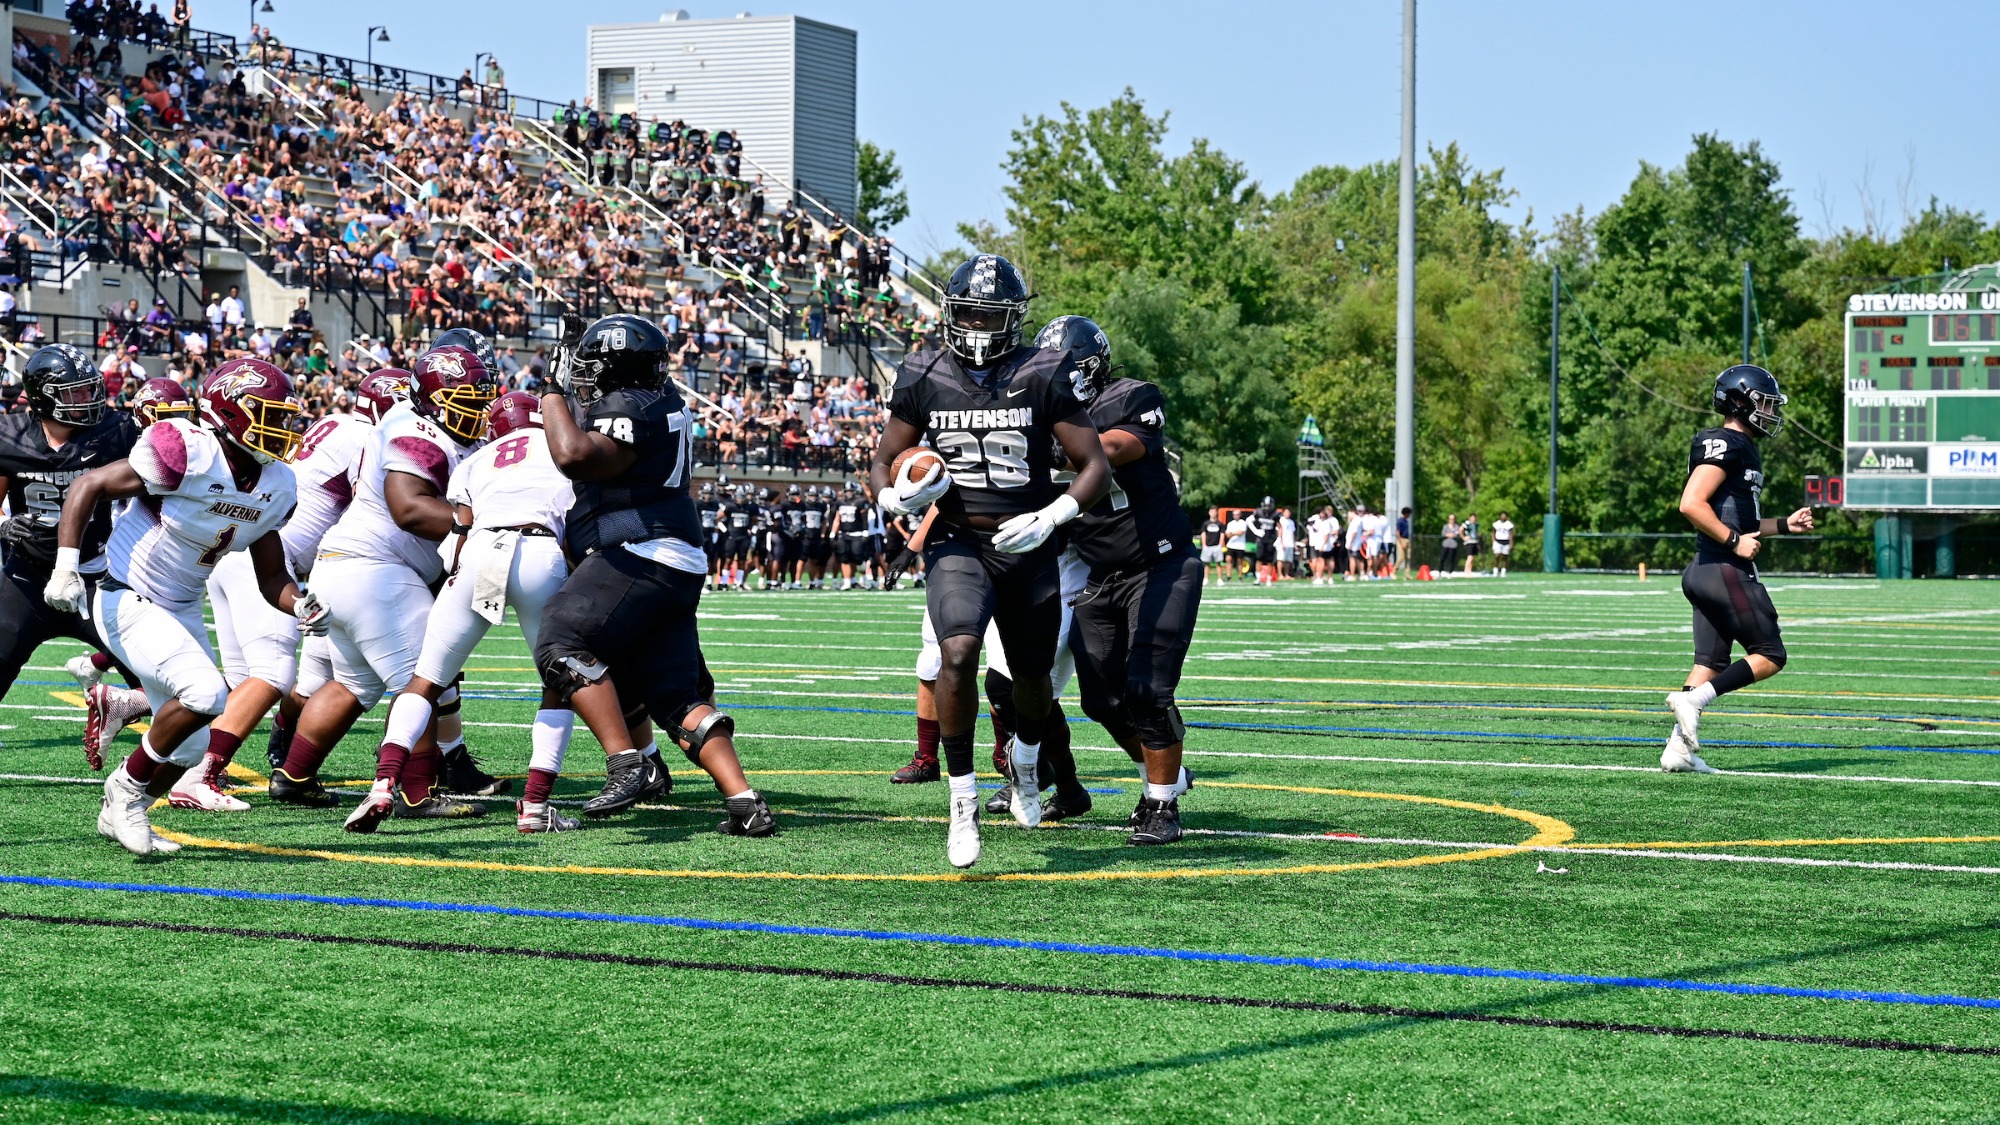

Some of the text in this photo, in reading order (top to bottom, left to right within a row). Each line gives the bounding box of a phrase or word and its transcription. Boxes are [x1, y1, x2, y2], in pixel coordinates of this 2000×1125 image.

[1849, 292, 1967, 312] STEVENSON
[597, 328, 626, 352] 78
[503, 398, 514, 411] 8
[1852, 397, 1927, 408] PLAYER PENALTY
[594, 417, 634, 443] 78
[929, 407, 1032, 429] STEVENSON
[493, 435, 531, 470] 8
[663, 405, 693, 487] 7
[1702, 439, 1728, 460] 12
[936, 430, 1030, 488] 28
[1808, 478, 1842, 504] 40
[209, 501, 263, 523] ALVERNIA
[197, 524, 239, 567] 1
